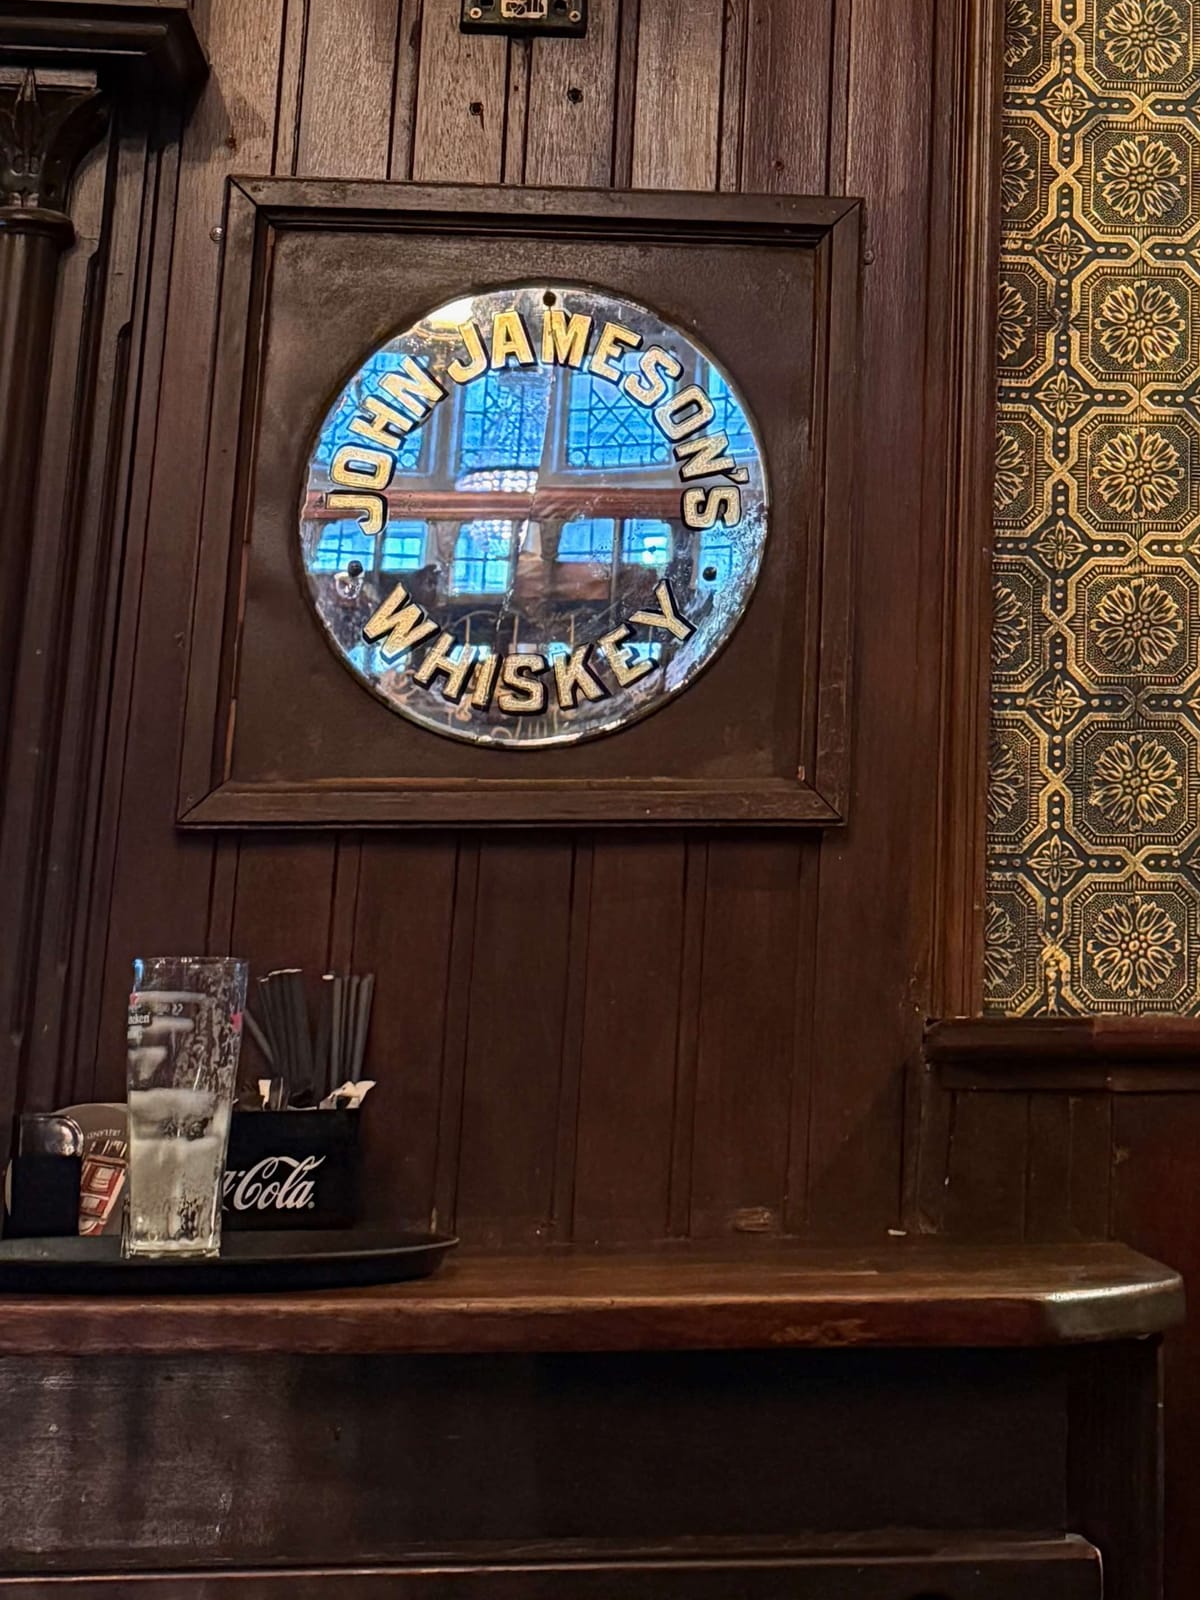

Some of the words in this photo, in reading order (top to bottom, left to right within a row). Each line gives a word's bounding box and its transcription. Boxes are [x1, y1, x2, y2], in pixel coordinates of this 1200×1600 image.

[325, 356, 448, 536] JOHN
[447, 309, 749, 530] JAMESON'S
[362, 579, 698, 716] WHISKEY
